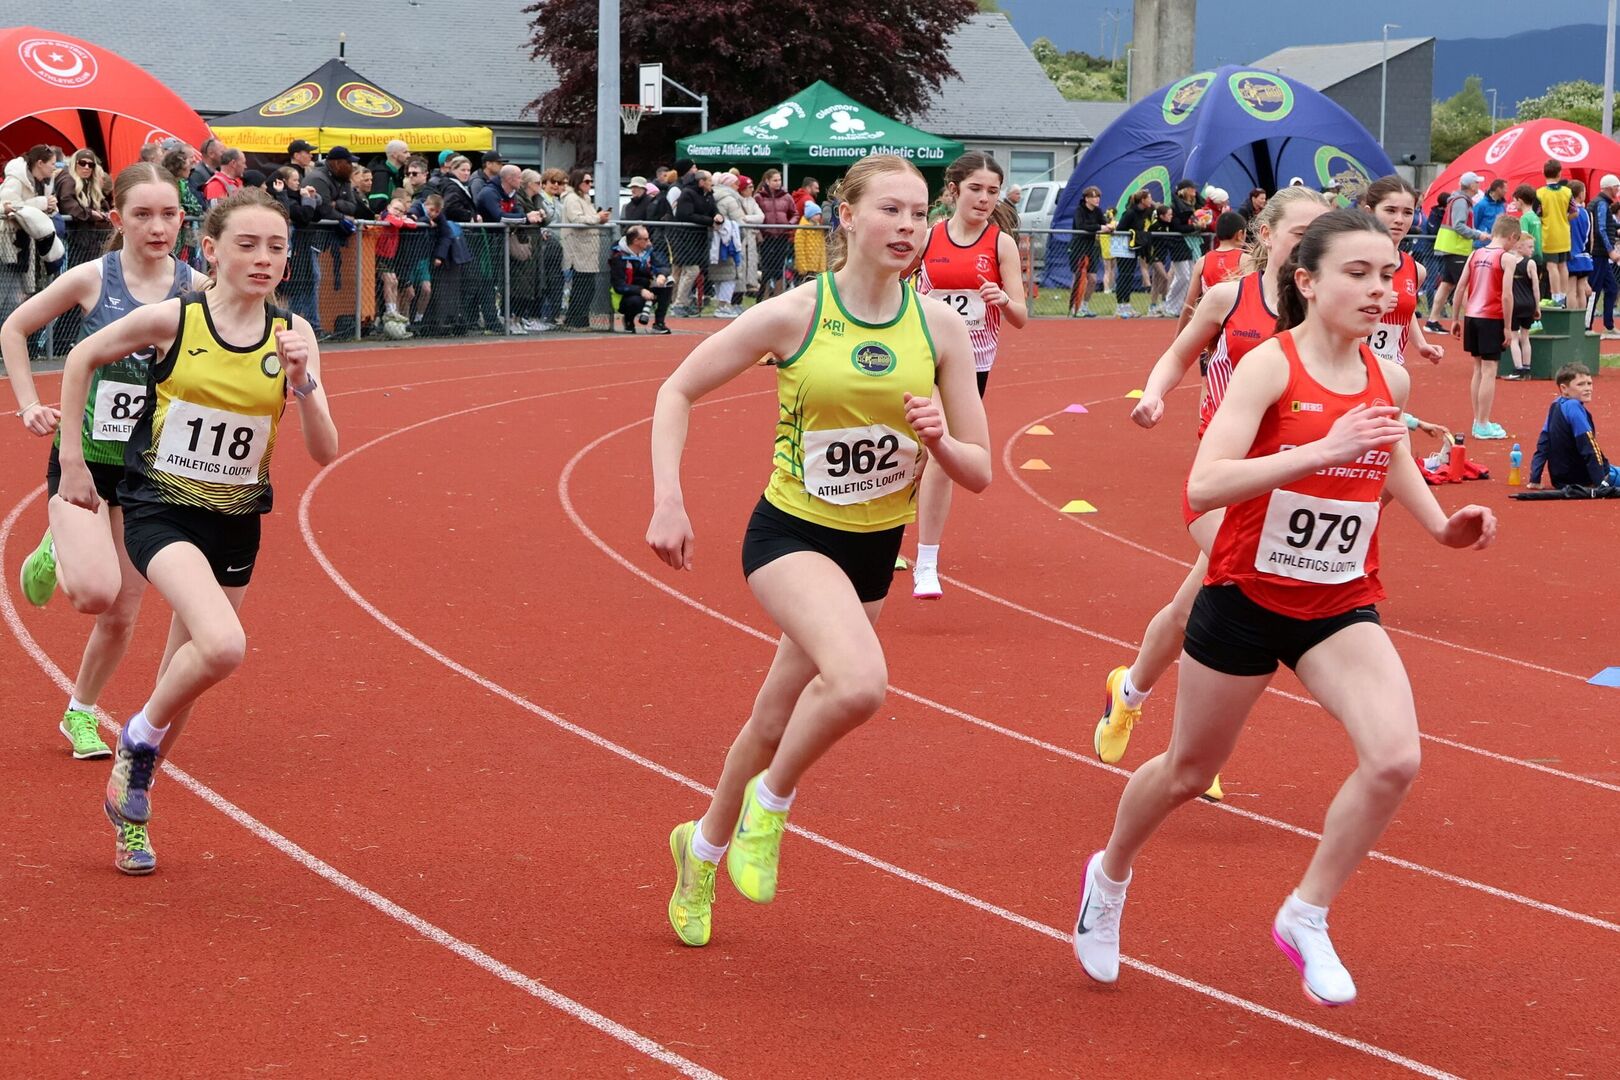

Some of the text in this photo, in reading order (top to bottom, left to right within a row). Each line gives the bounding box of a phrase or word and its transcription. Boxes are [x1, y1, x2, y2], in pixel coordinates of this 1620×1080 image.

[816, 104, 859, 119] Glenmore
[238, 131, 273, 145] Athletic
[273, 132, 296, 145] Club
[400, 131, 440, 145] Athletic
[442, 132, 467, 145] Club
[687, 143, 771, 157] Glenmore Athletic Club
[809, 145, 944, 159] Glenmore Athletic Club
[943, 295, 968, 316] 12
[1232, 328, 1262, 339] oneills
[126, 371, 146, 379] CLU
[187, 417, 254, 461] 118
[825, 434, 900, 478] 962
[166, 453, 253, 477] ATHLETICS LOUTH
[1316, 466, 1368, 479] STRICT
[817, 470, 906, 497] ATHLETICS LOUTH
[1286, 508, 1362, 555] 979
[1268, 551, 1357, 573] ATHLETICS LOUTH
